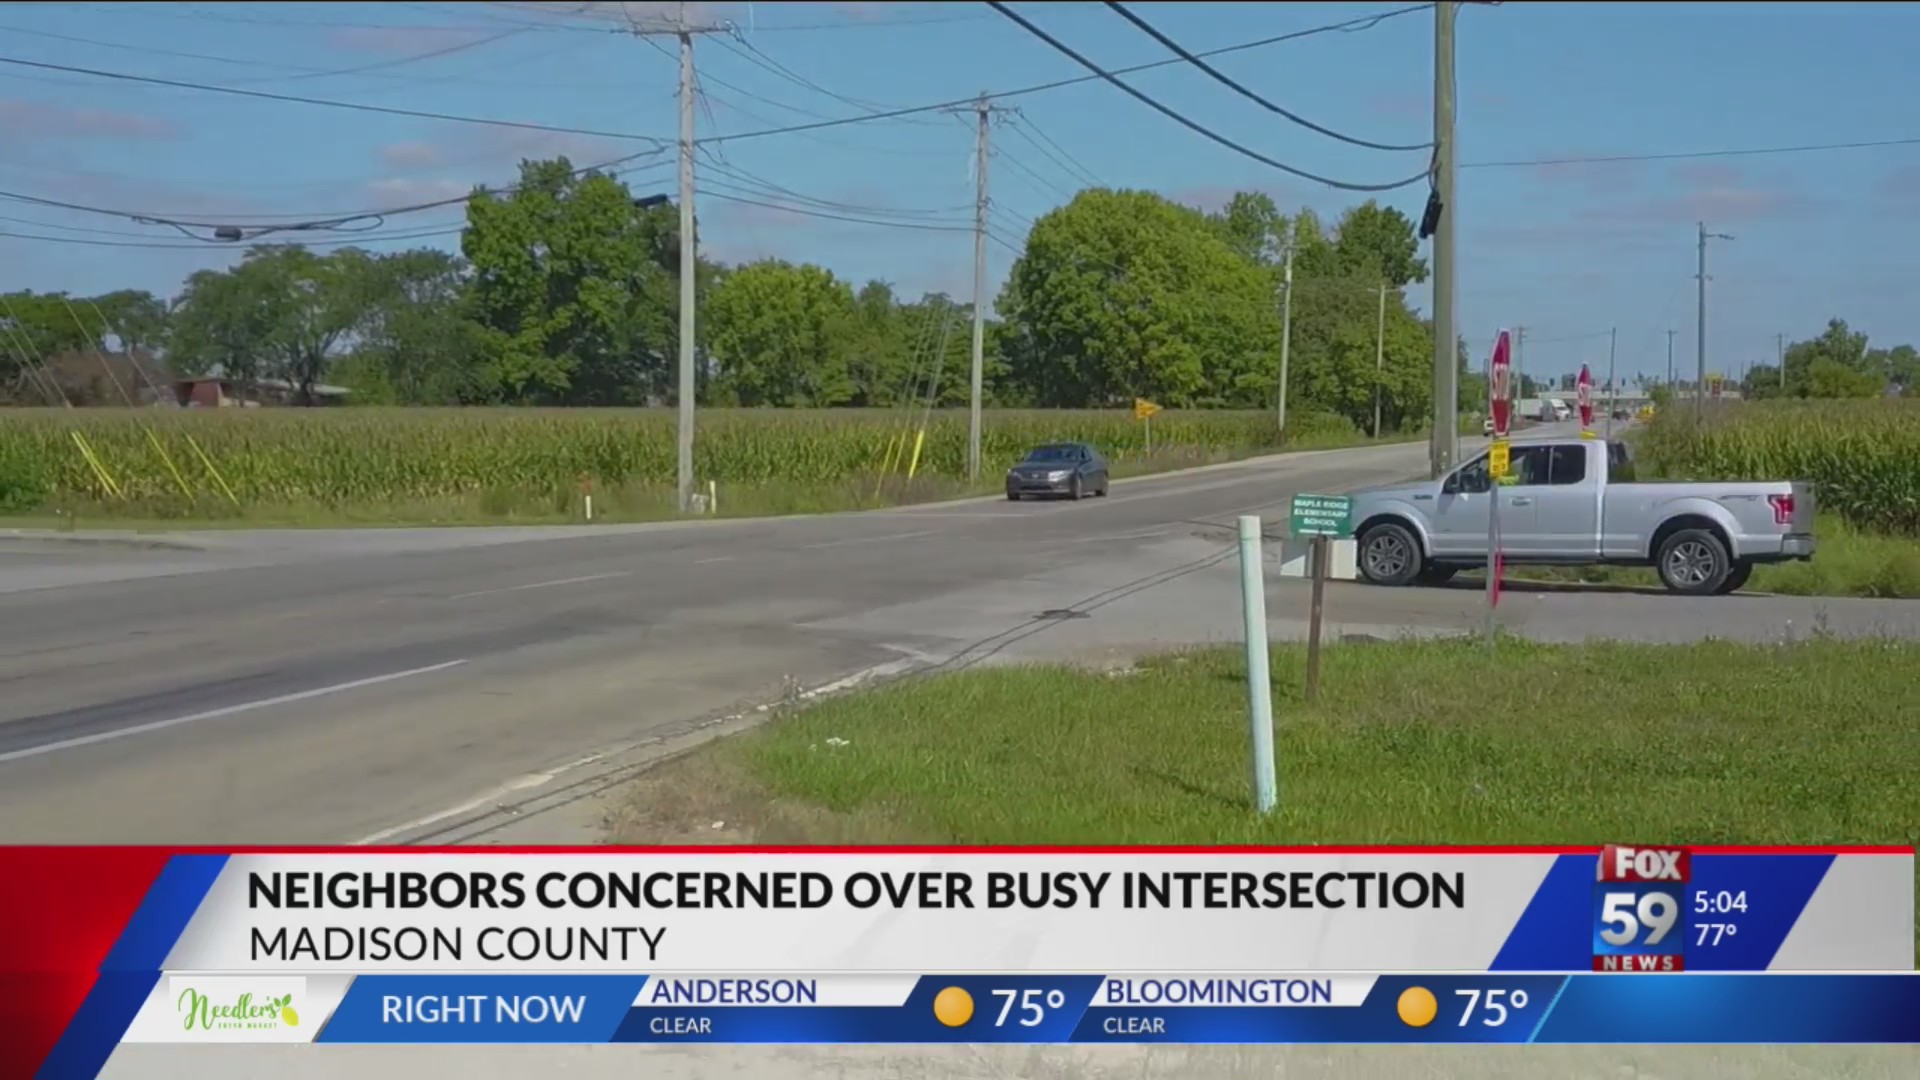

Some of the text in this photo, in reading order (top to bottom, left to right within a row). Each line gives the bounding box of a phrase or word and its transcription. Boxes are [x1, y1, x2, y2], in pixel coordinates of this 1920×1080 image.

[1294, 499, 1349, 510] MAPLE RIDGE
[1294, 508, 1349, 518] ELEMENTARY
[1303, 518, 1338, 527] SCHOOL
